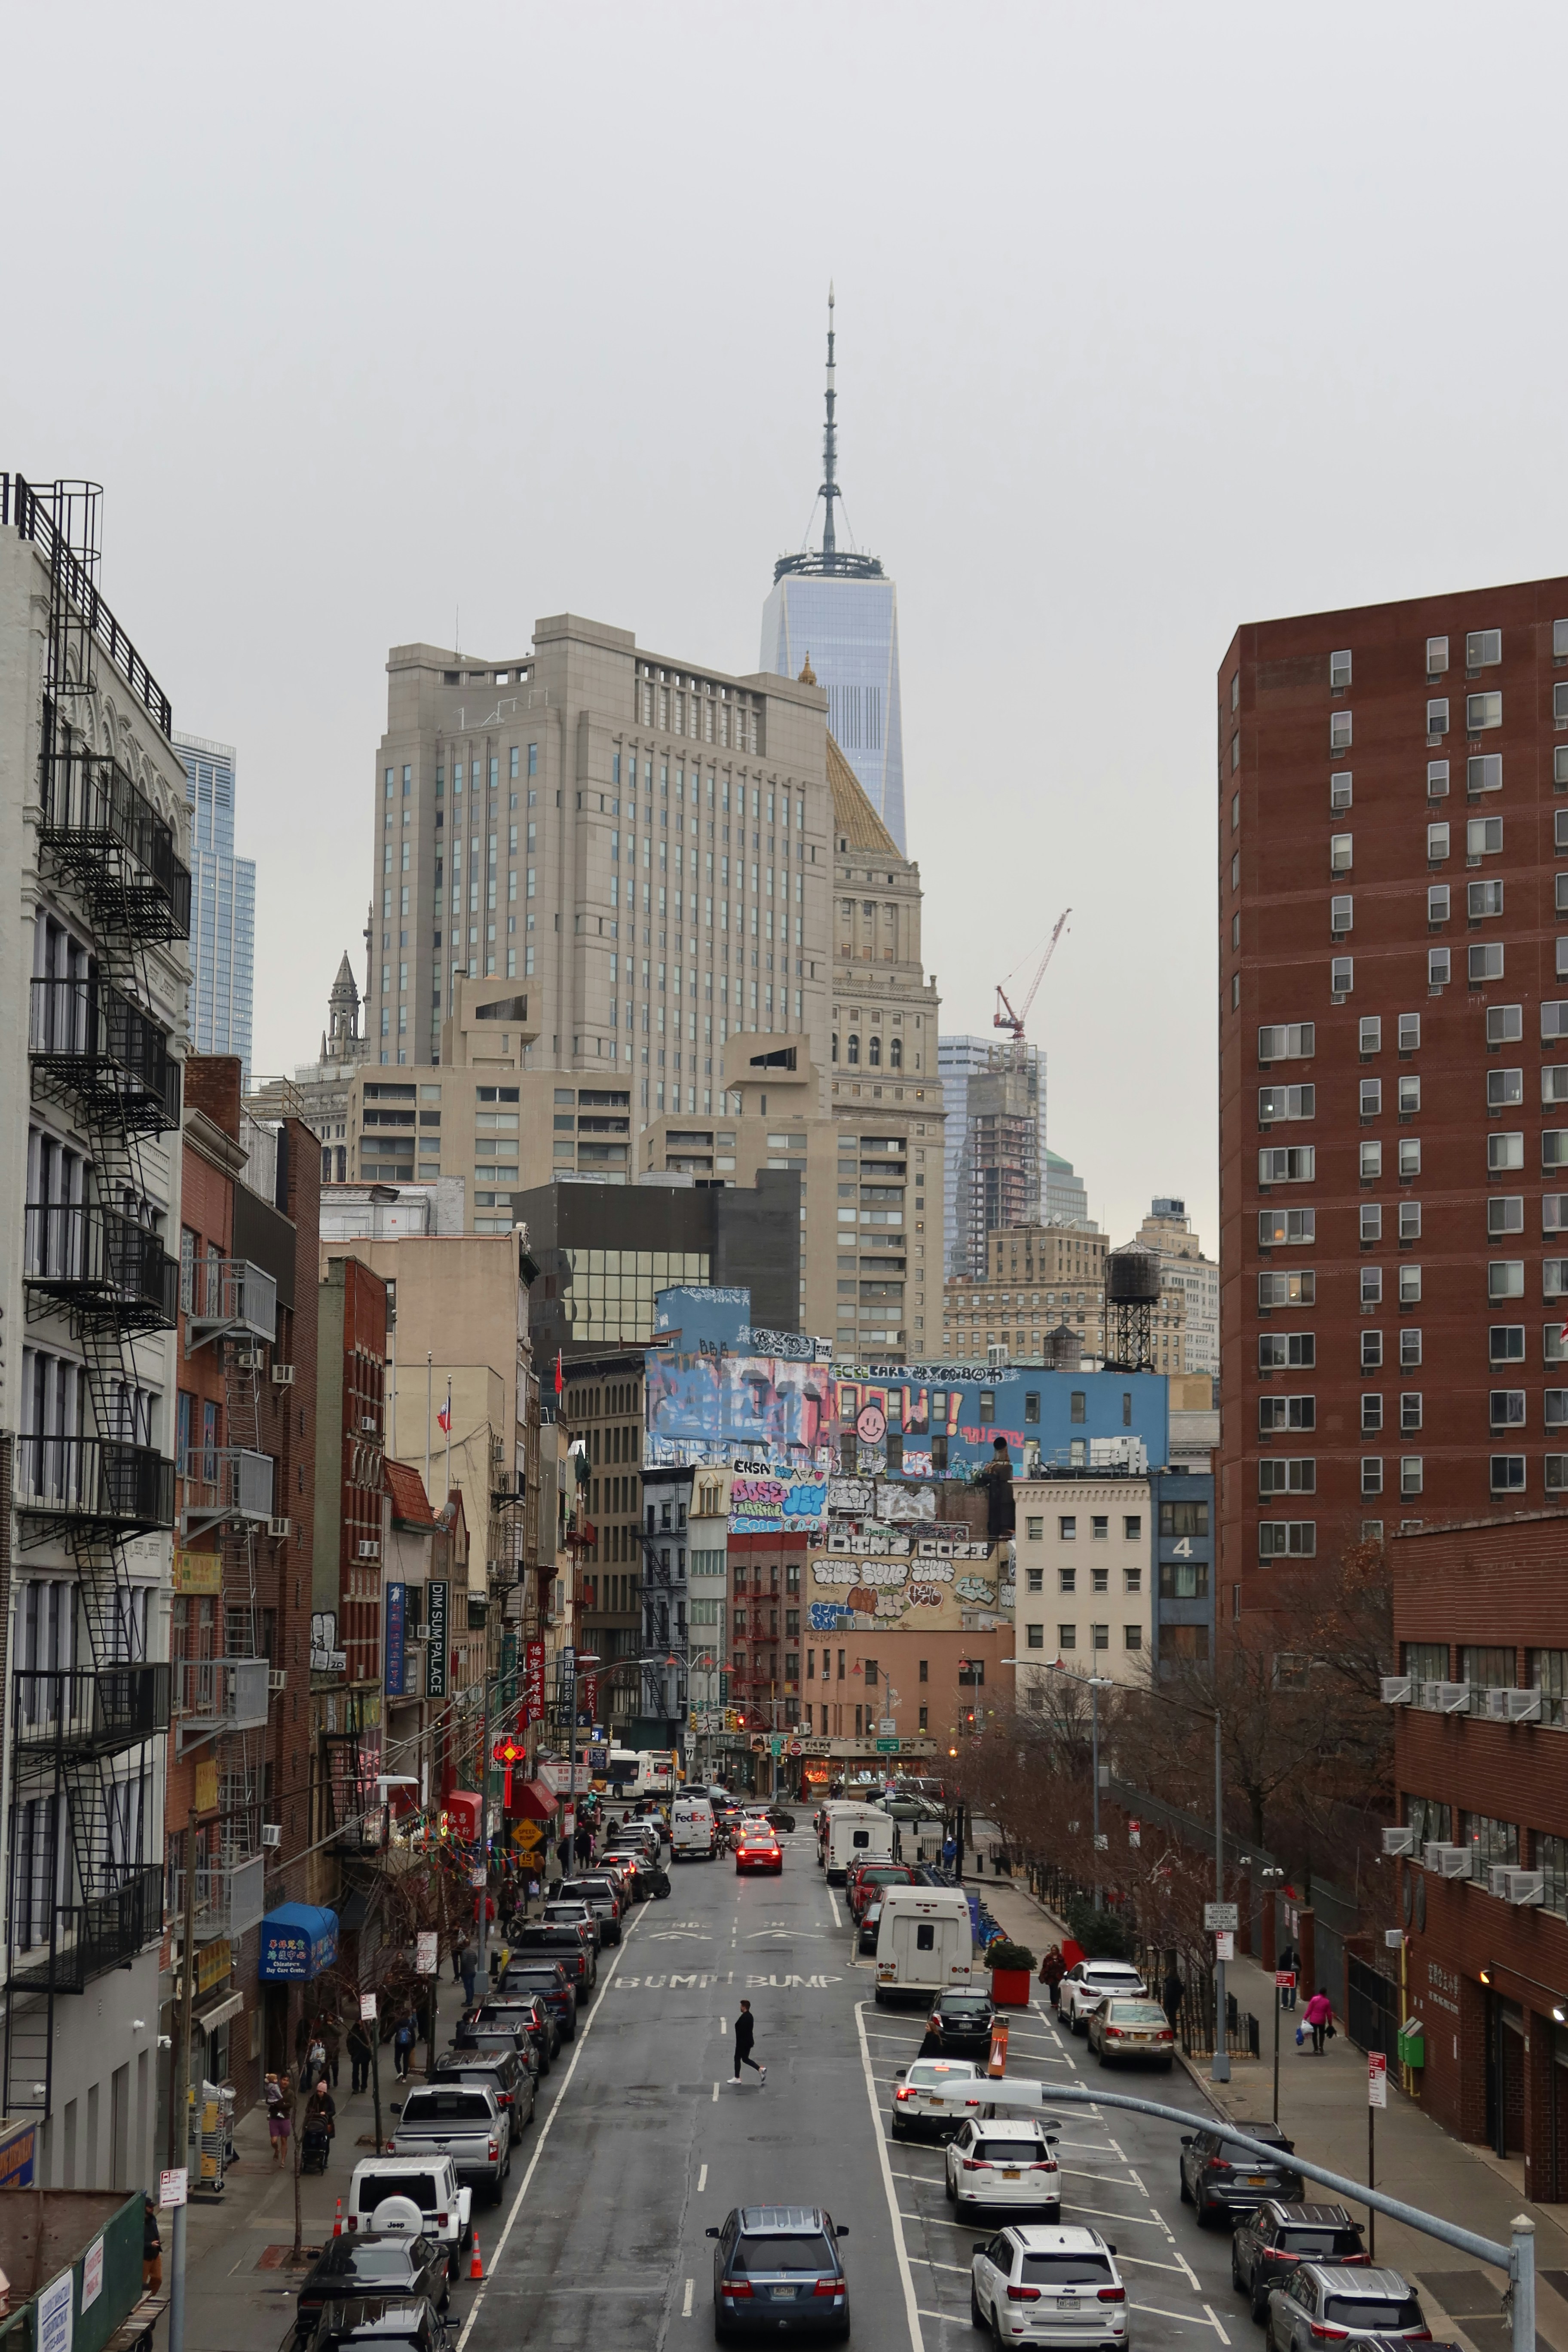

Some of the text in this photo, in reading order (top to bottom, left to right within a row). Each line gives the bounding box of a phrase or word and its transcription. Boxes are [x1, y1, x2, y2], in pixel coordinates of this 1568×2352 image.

[734, 1459, 770, 1475] EKSA
[732, 1479, 788, 1504] DOSE
[782, 1482, 827, 1516] JET
[1173, 1537, 1193, 1558] 4
[430, 1584, 443, 1694] DIM SUM PALACE
[675, 1812, 706, 1822] FedEx
[745, 1975, 843, 1989] BUMP
